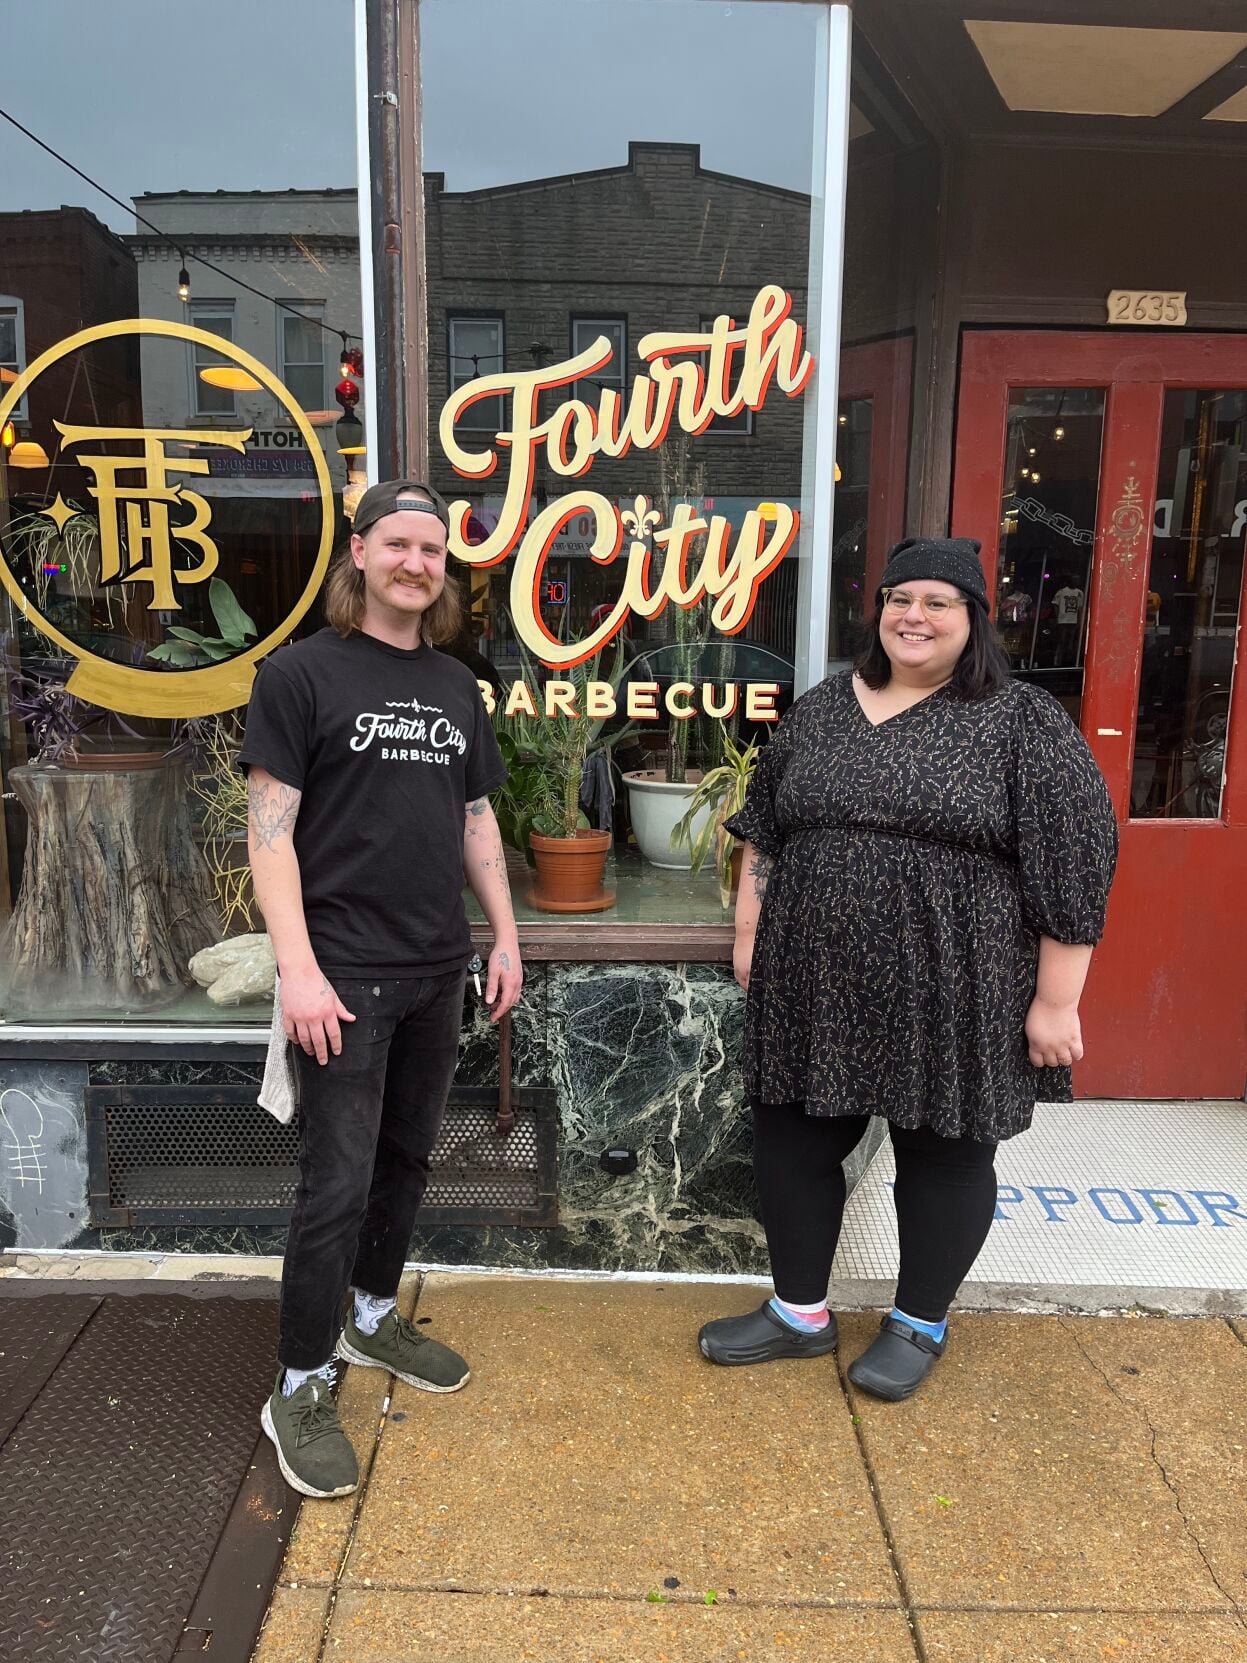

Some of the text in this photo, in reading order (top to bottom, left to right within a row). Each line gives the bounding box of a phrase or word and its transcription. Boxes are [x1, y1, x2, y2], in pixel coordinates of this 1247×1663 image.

[1116, 294, 1180, 321] 2635
[439, 284, 815, 567] Fourth
[510, 491, 799, 670] City
[350, 713, 466, 755] Fourth City
[382, 748, 450, 765] BARBECUE
